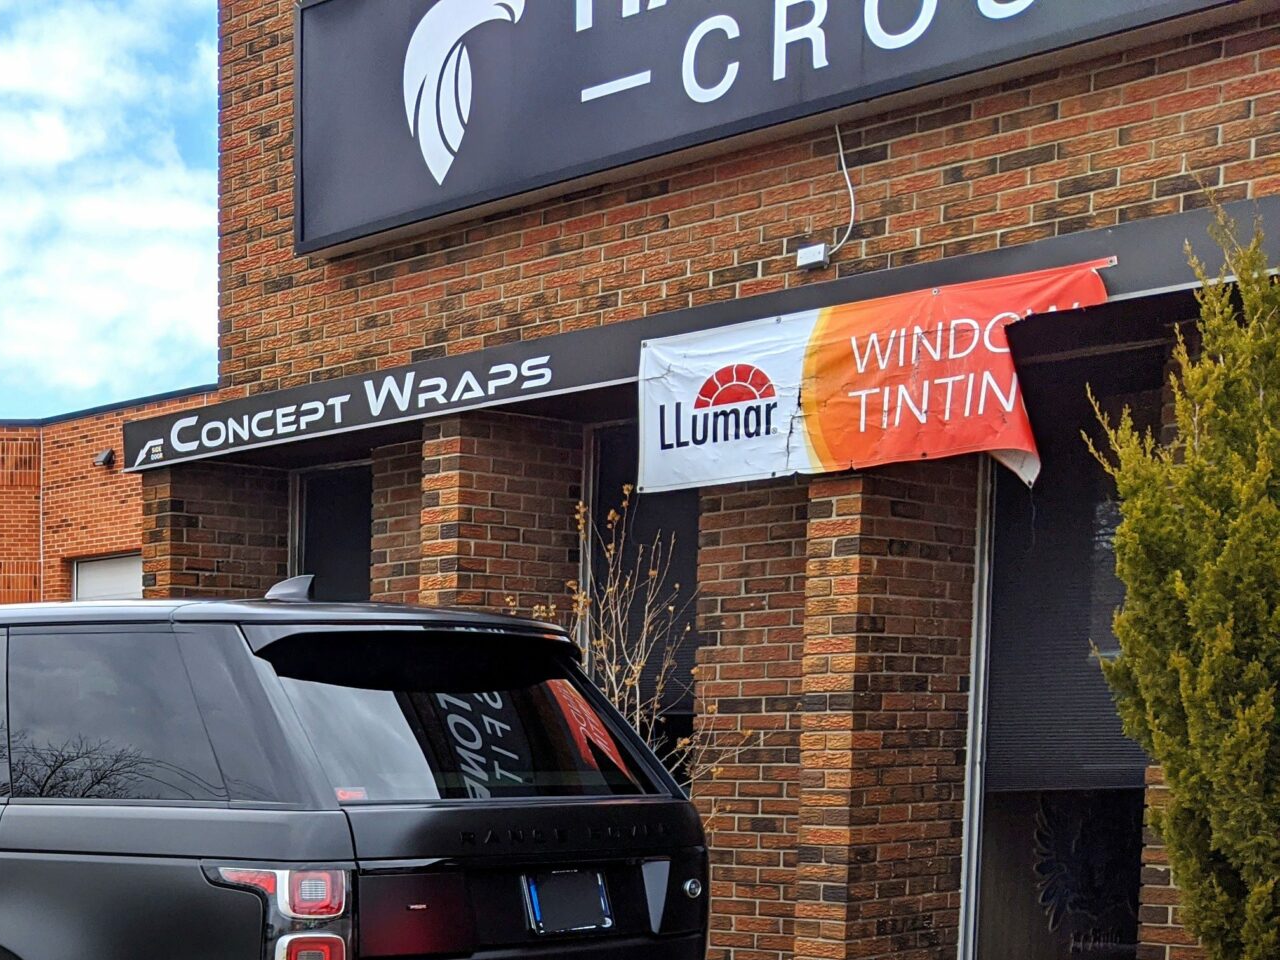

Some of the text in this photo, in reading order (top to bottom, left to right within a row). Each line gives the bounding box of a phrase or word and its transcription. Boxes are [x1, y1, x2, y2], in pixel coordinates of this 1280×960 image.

[681, 0, 1032, 104] CRO
[851, 302, 1080, 374] WINDO
[170, 355, 551, 453] CONCEPT WRAPS
[659, 400, 778, 451] LLumar
[848, 370, 1029, 433] TINTIN
